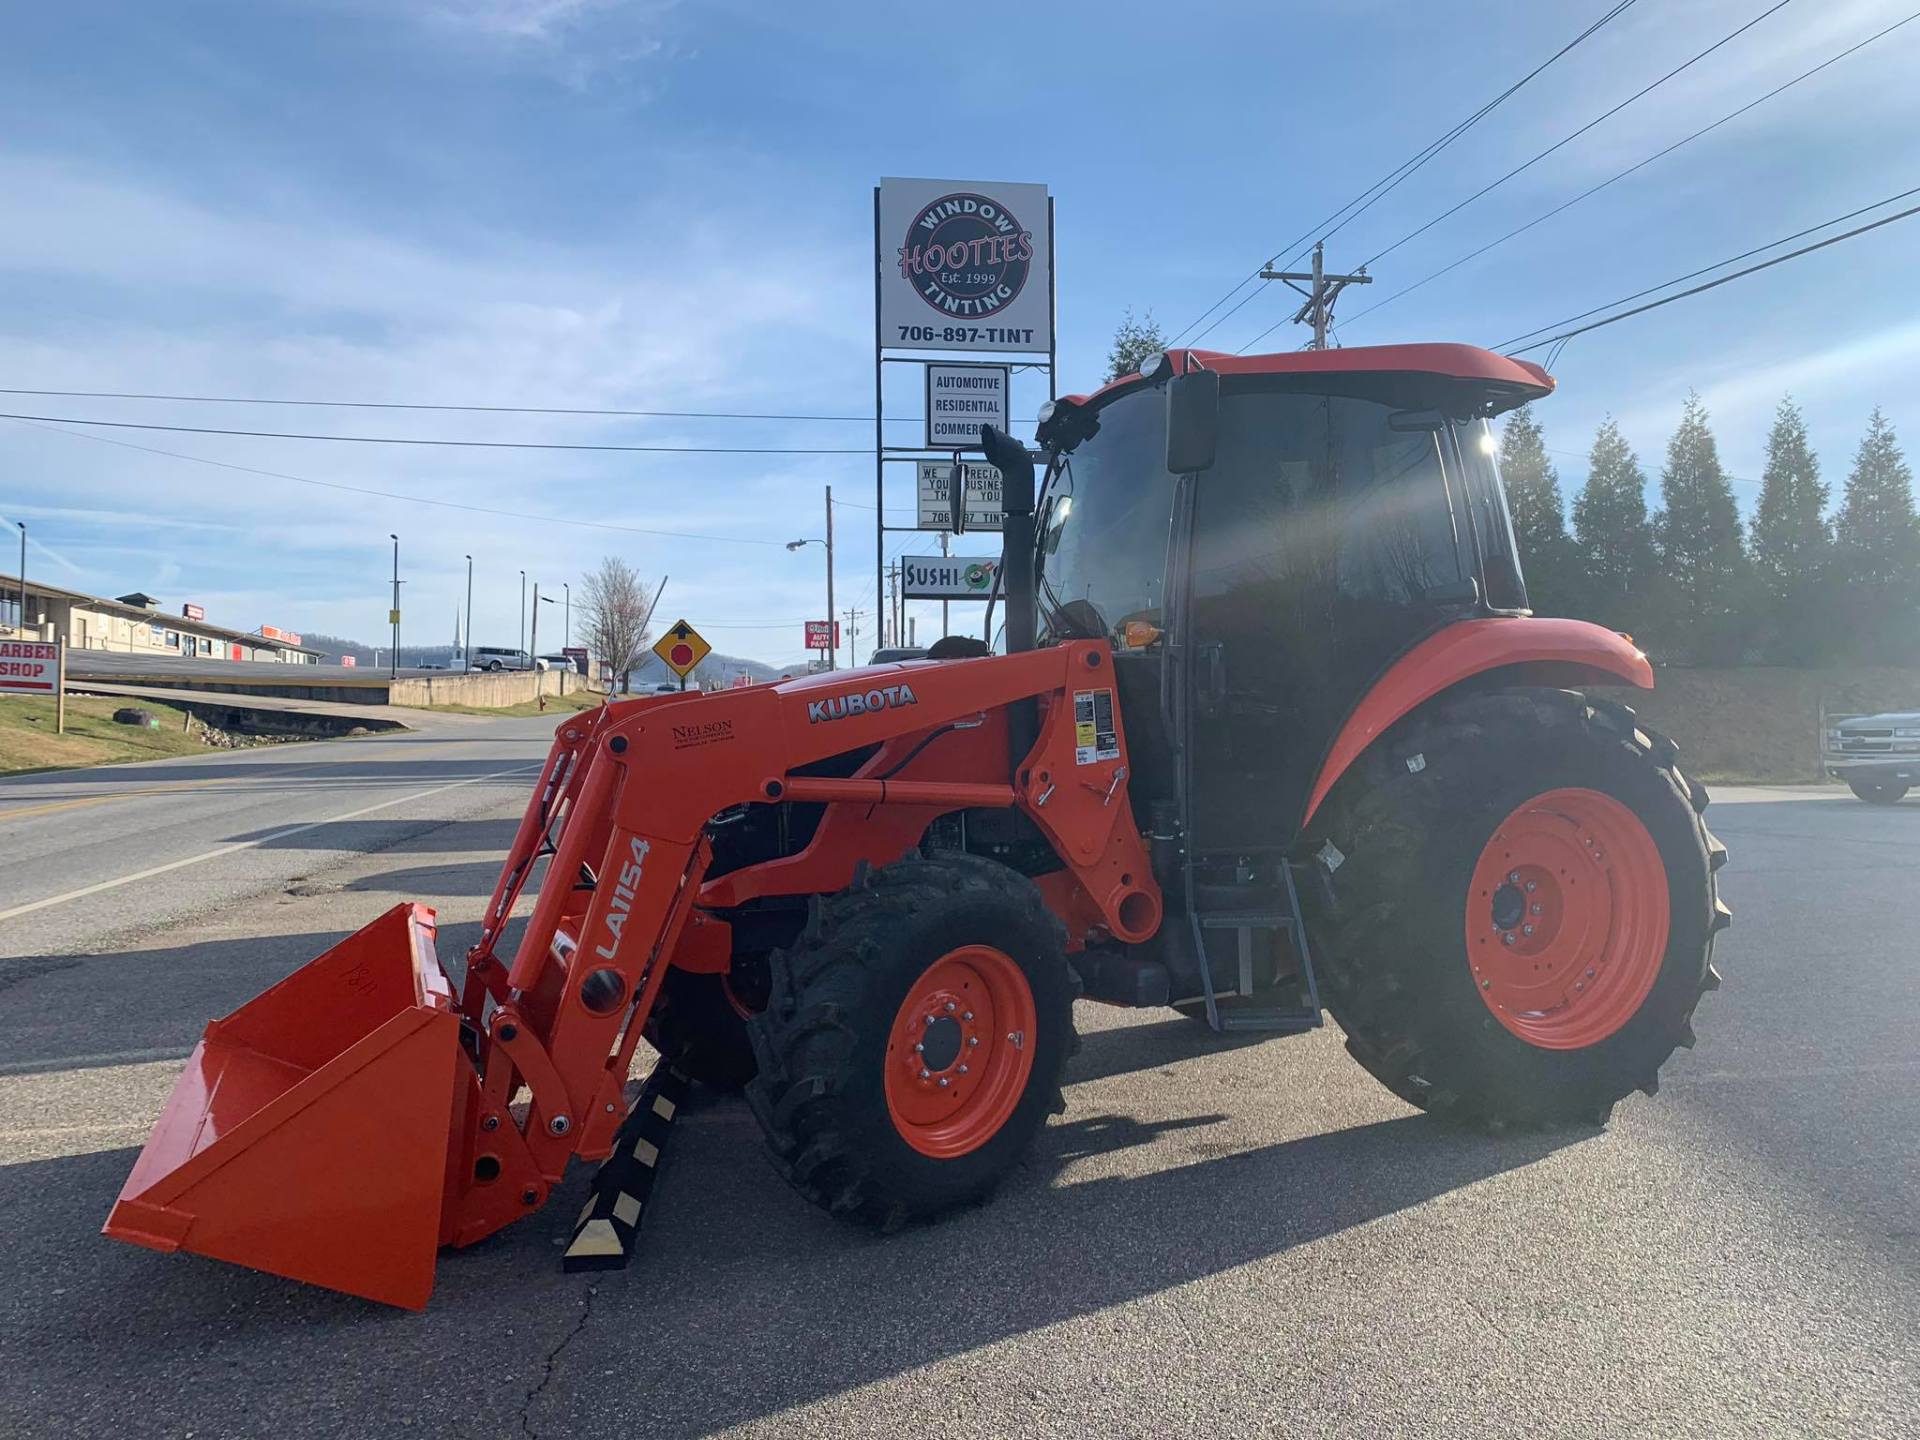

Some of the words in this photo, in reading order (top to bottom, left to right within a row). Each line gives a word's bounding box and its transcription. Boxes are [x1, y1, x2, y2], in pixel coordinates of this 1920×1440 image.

[920, 199, 1014, 234] WINDOW
[898, 231, 1033, 279] HOOTIES
[941, 272, 961, 284] Est.
[967, 273, 996, 284] 1999
[923, 281, 1012, 314] TINTING
[898, 325, 1034, 344] 706-897-TINT
[936, 375, 1000, 389] AUTOMOTIVE
[935, 399, 1000, 413] RESIDENTIAL
[934, 422, 1000, 435] COMMERC
[922, 468, 937, 479] WE
[929, 479, 949, 489] YOU
[966, 480, 1003, 490] BUSINE
[931, 513, 950, 522] 706
[906, 563, 958, 586] SUSHI
[0, 643, 56, 660] ARBER
[0, 661, 44, 677] SHOP
[807, 684, 918, 724] KUBOTA
[595, 836, 651, 960] LA1154
